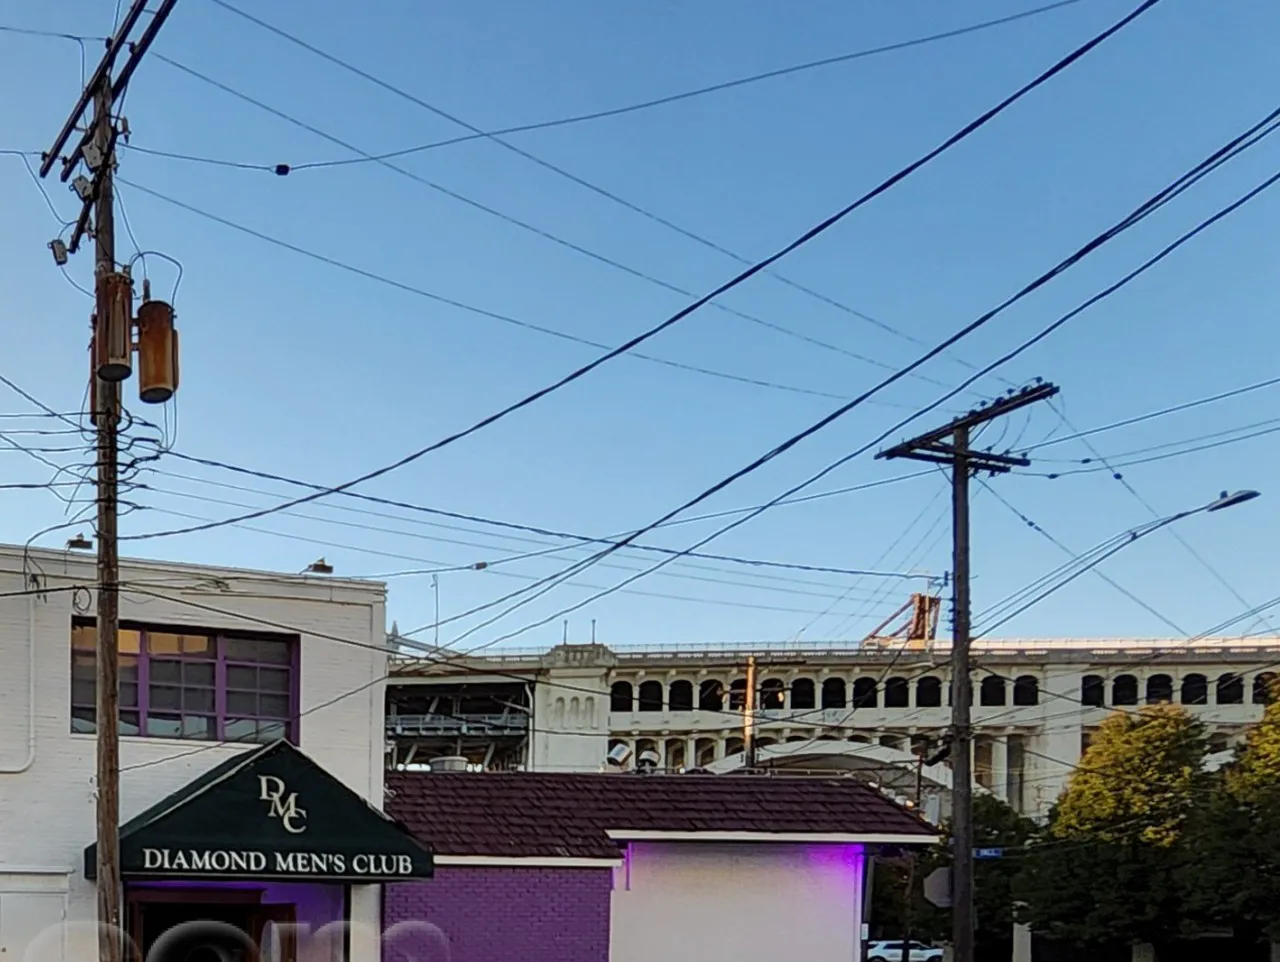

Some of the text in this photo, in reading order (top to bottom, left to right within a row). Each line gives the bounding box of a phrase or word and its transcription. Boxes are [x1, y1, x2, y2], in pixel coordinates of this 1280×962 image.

[257, 774, 307, 834] DMC
[142, 848, 413, 875] DIAMOND MEN'S CLUB
